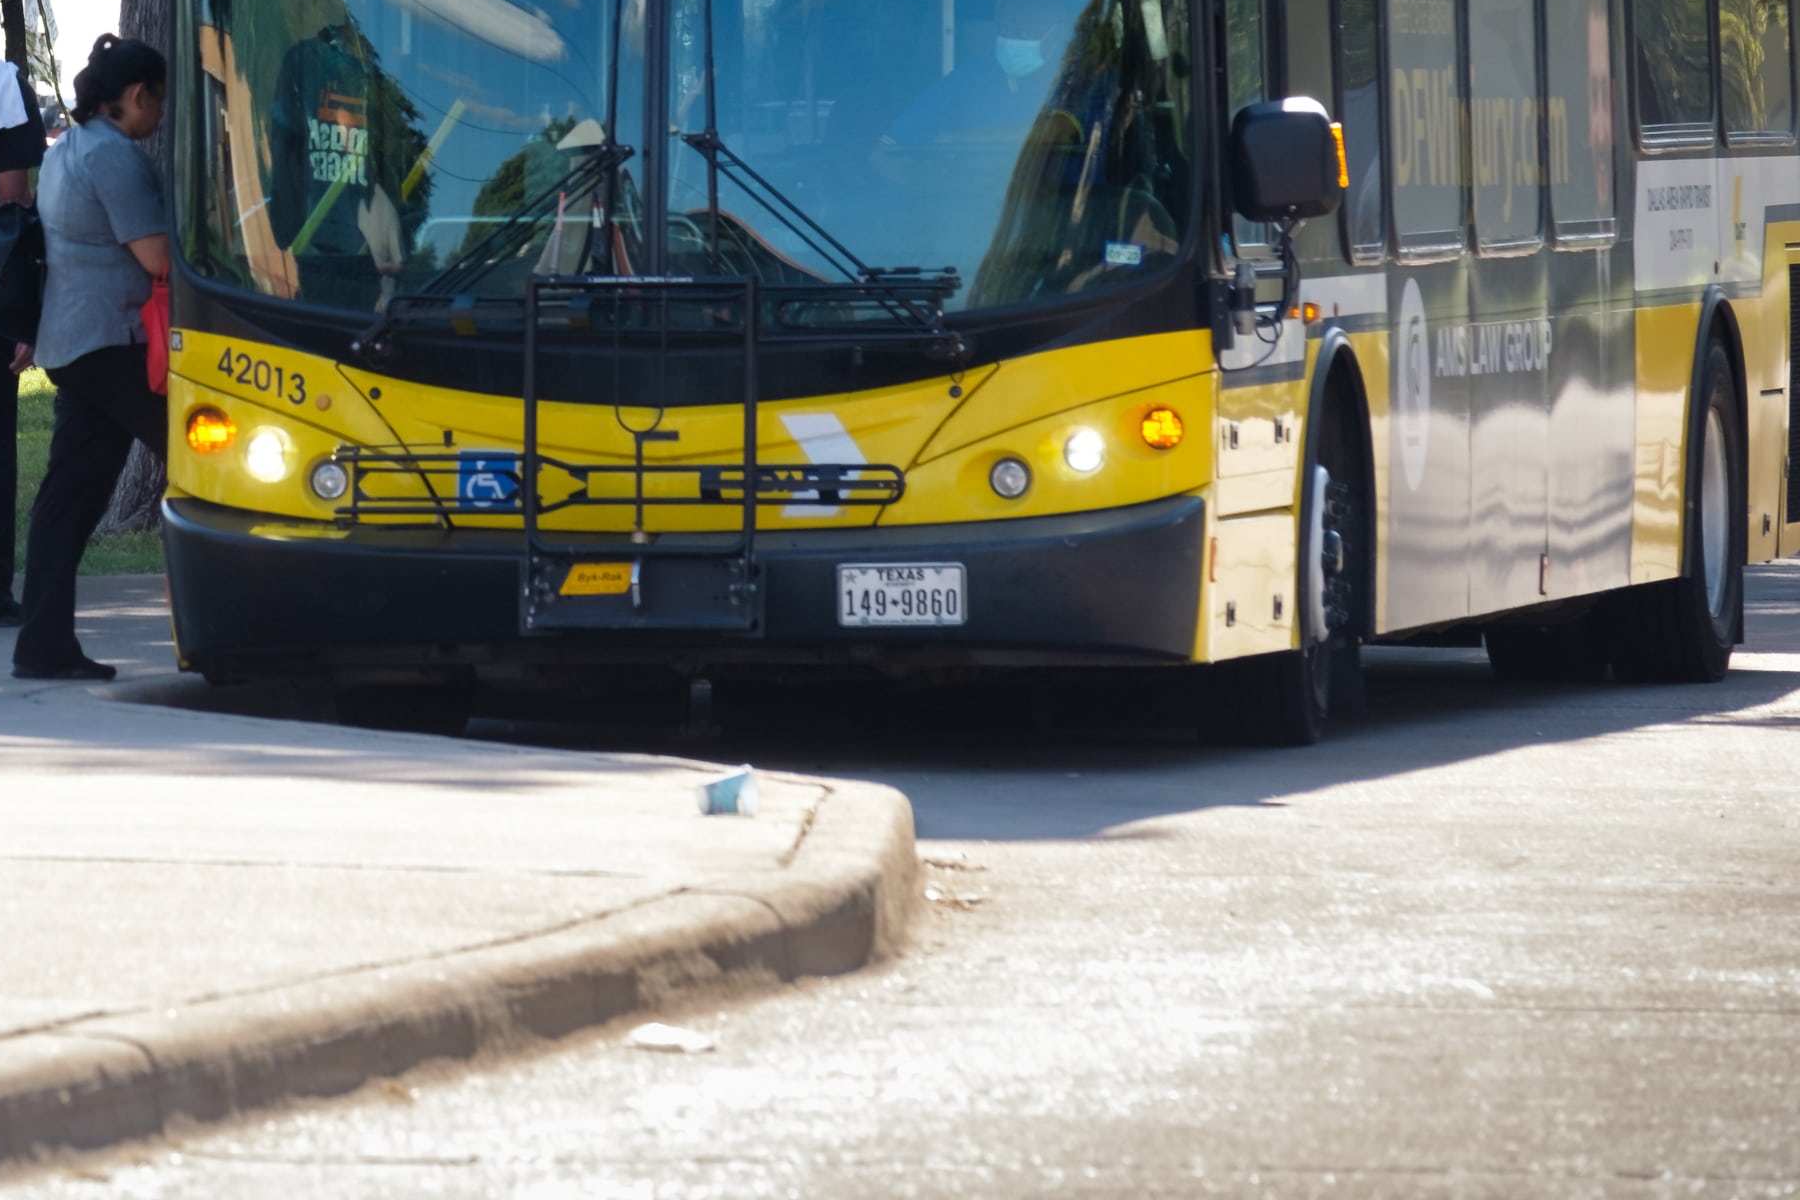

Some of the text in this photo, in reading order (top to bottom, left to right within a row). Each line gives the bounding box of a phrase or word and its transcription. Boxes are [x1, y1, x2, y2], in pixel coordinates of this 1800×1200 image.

[217, 346, 307, 405] 42013
[1436, 320, 1553, 377] AMS LAW GROUP
[875, 568, 925, 581] TEXAS
